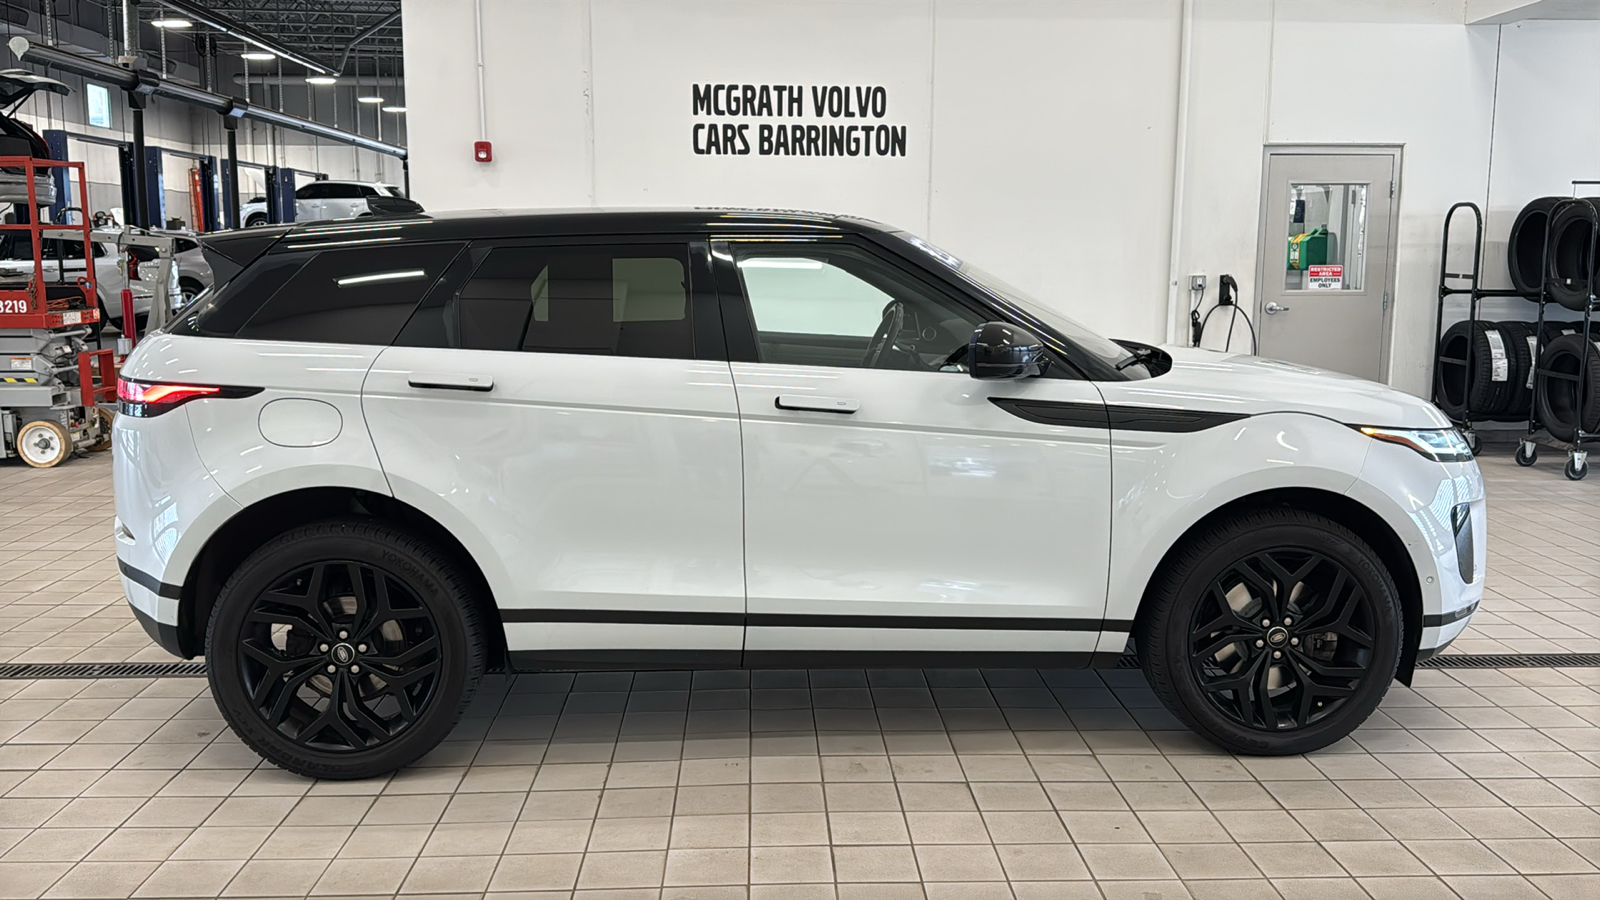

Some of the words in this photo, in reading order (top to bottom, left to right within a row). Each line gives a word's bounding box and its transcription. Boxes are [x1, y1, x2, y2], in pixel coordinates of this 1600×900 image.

[692, 84, 803, 117] MCGRATH
[811, 86, 887, 118] VOLVO
[692, 123, 750, 155] CARS
[758, 124, 907, 157] BARRINGTON
[382, 549, 439, 597] YOKOHAMA
[1357, 555, 1393, 612] YOKOHAMA
